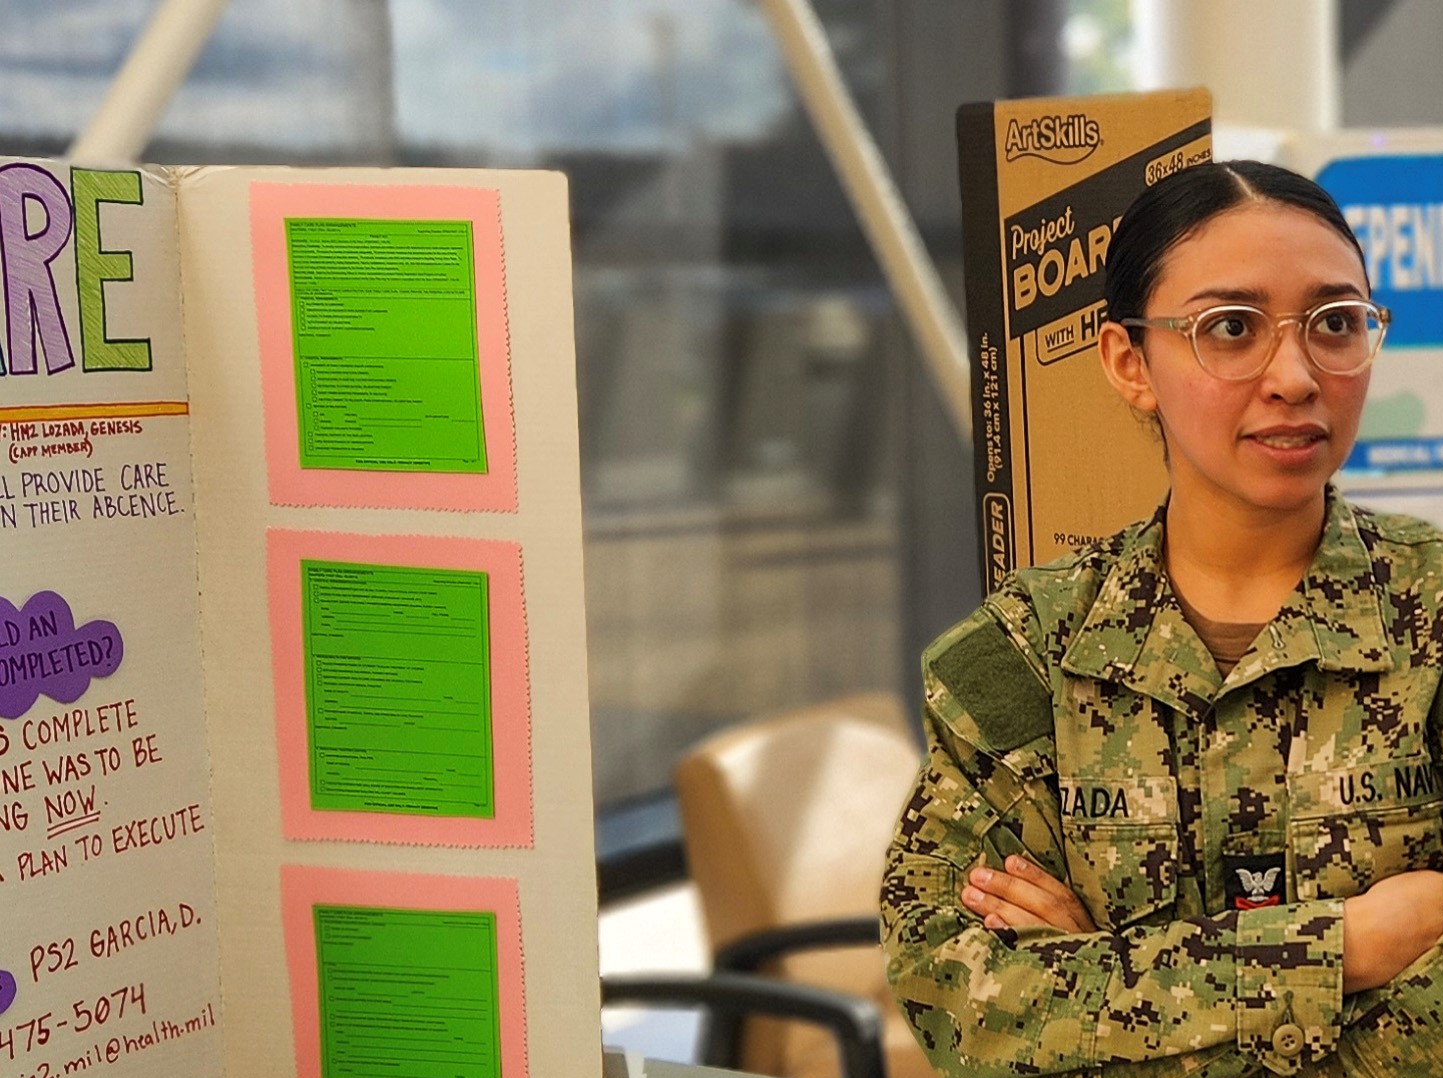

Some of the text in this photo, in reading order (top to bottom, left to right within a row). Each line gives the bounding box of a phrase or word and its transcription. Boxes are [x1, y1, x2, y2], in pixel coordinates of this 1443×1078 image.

[1005, 113, 1100, 152] ArtSkills
[1011, 205, 1075, 260] Project
[1013, 215, 1124, 311] BOAR
[1045, 324, 1075, 351] WITH
[981, 351, 989, 369] 48
[988, 346, 998, 371] cm)
[990, 374, 999, 399] 121
[983, 400, 992, 417] 36
[992, 412, 1000, 432] cm
[11, 422, 39, 442] HM2
[90, 419, 143, 436] GENESIS
[986, 443, 997, 483] Opens
[992, 434, 1003, 469] (91.4
[0, 462, 170, 501] L PROVIDE CARE
[23, 498, 81, 528] THEIR
[93, 491, 185, 520] ABCENCE.
[1054, 533, 1066, 545] 99
[0, 610, 58, 648] D AN
[22, 699, 138, 750] COMPLETE
[42, 752, 92, 786] WAS
[94, 746, 121, 776] TO
[132, 734, 163, 767] BE
[1339, 771, 1383, 805] U.S.
[18, 804, 205, 881] PLAN TO EXECUTE
[30, 938, 79, 983] PS2
